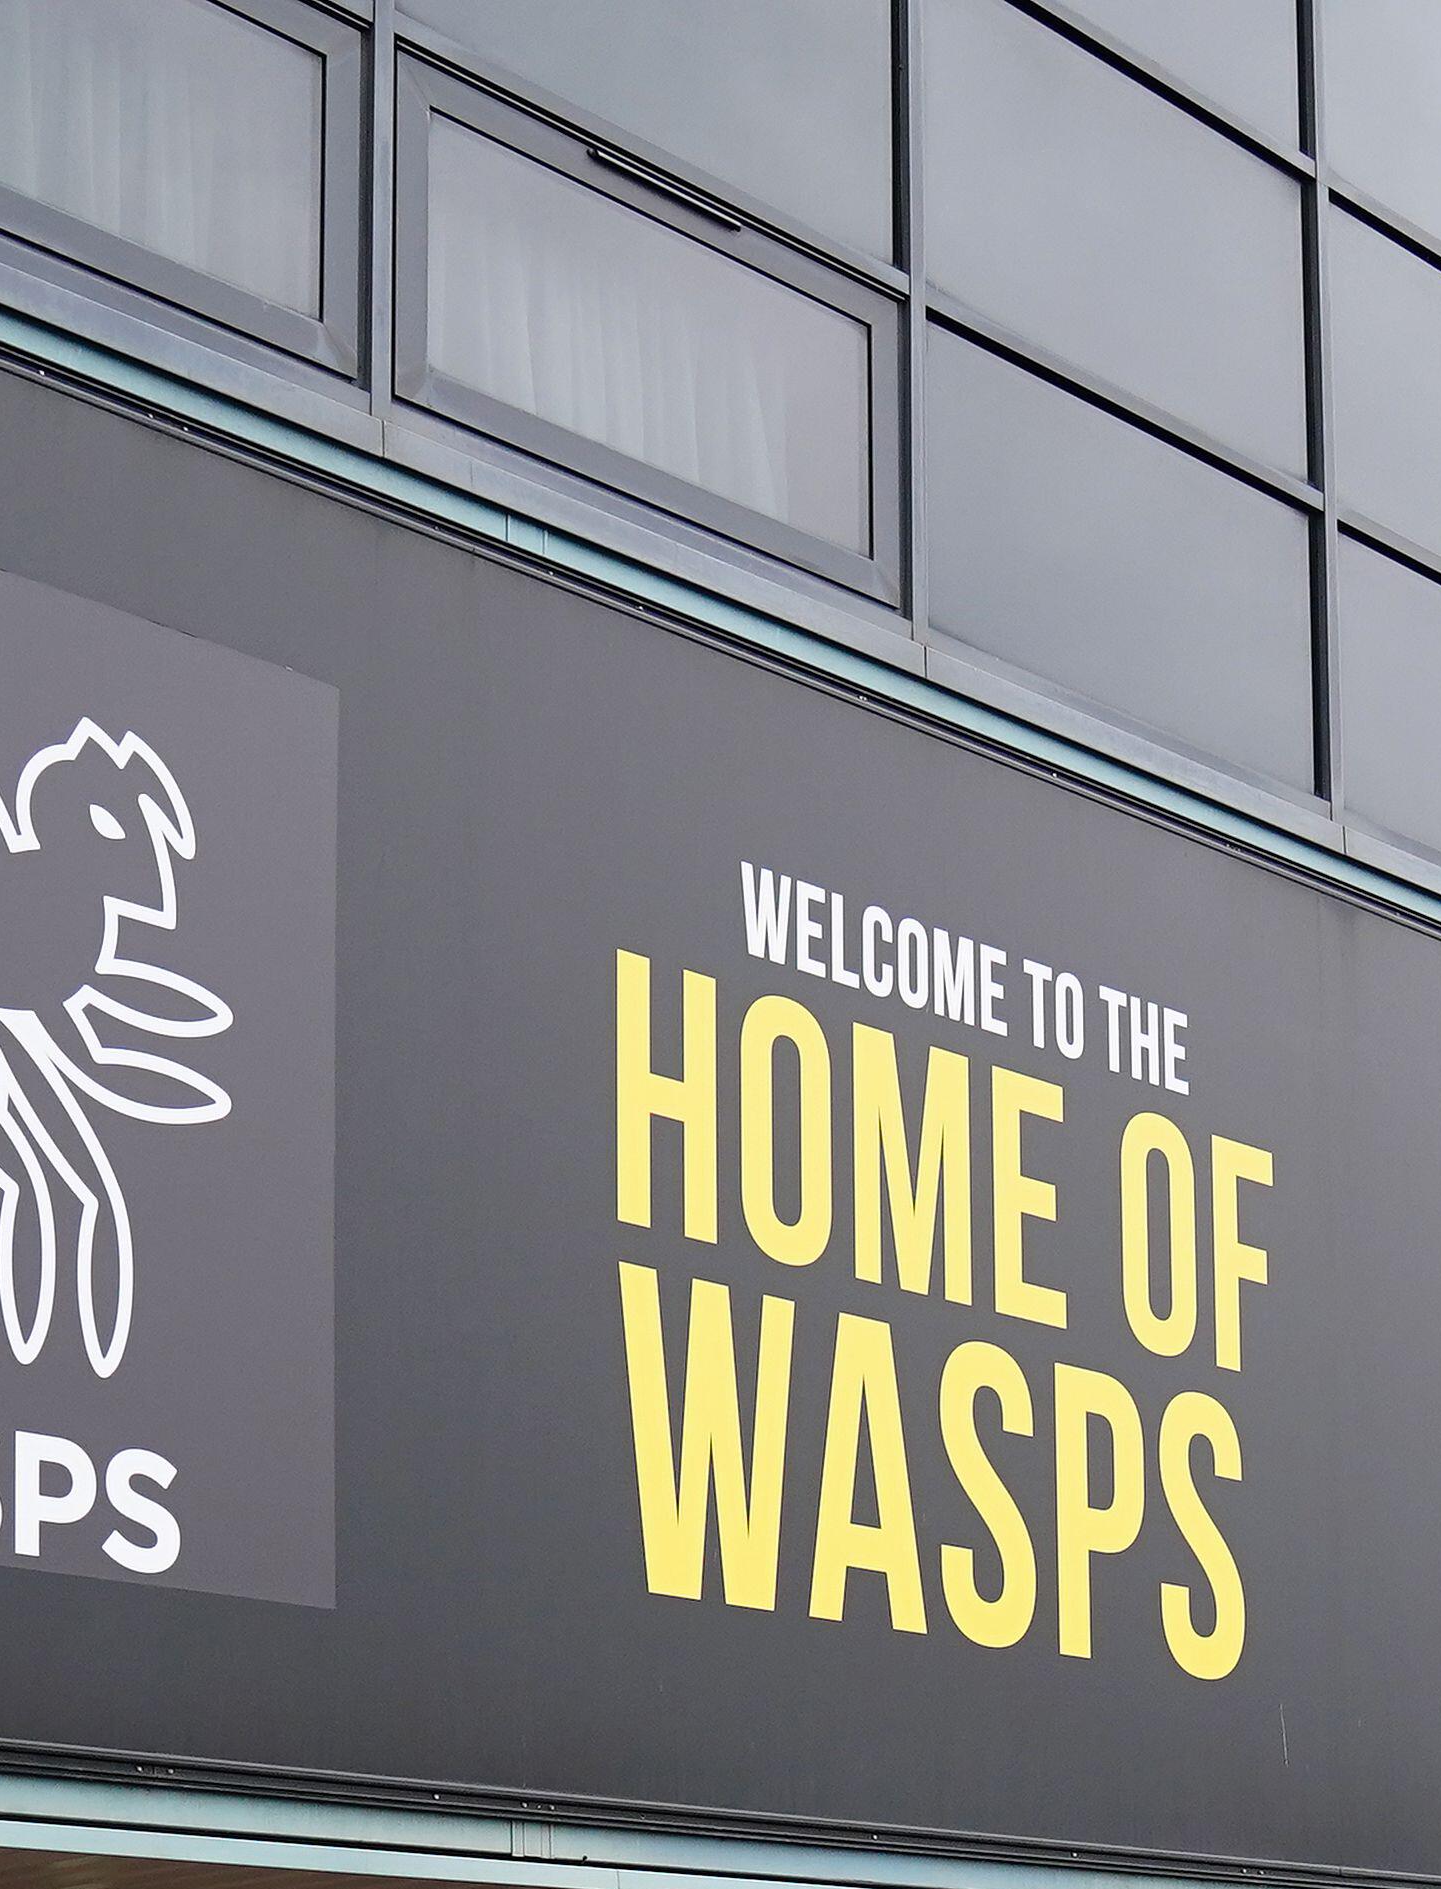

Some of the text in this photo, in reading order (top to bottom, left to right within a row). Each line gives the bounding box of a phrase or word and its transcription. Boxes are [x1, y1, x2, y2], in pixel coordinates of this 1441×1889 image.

[616, 948, 1274, 1373] HOME OF
[740, 861, 1190, 1096] WELCOME TO THE
[617, 1260, 1248, 1683] WASPS
